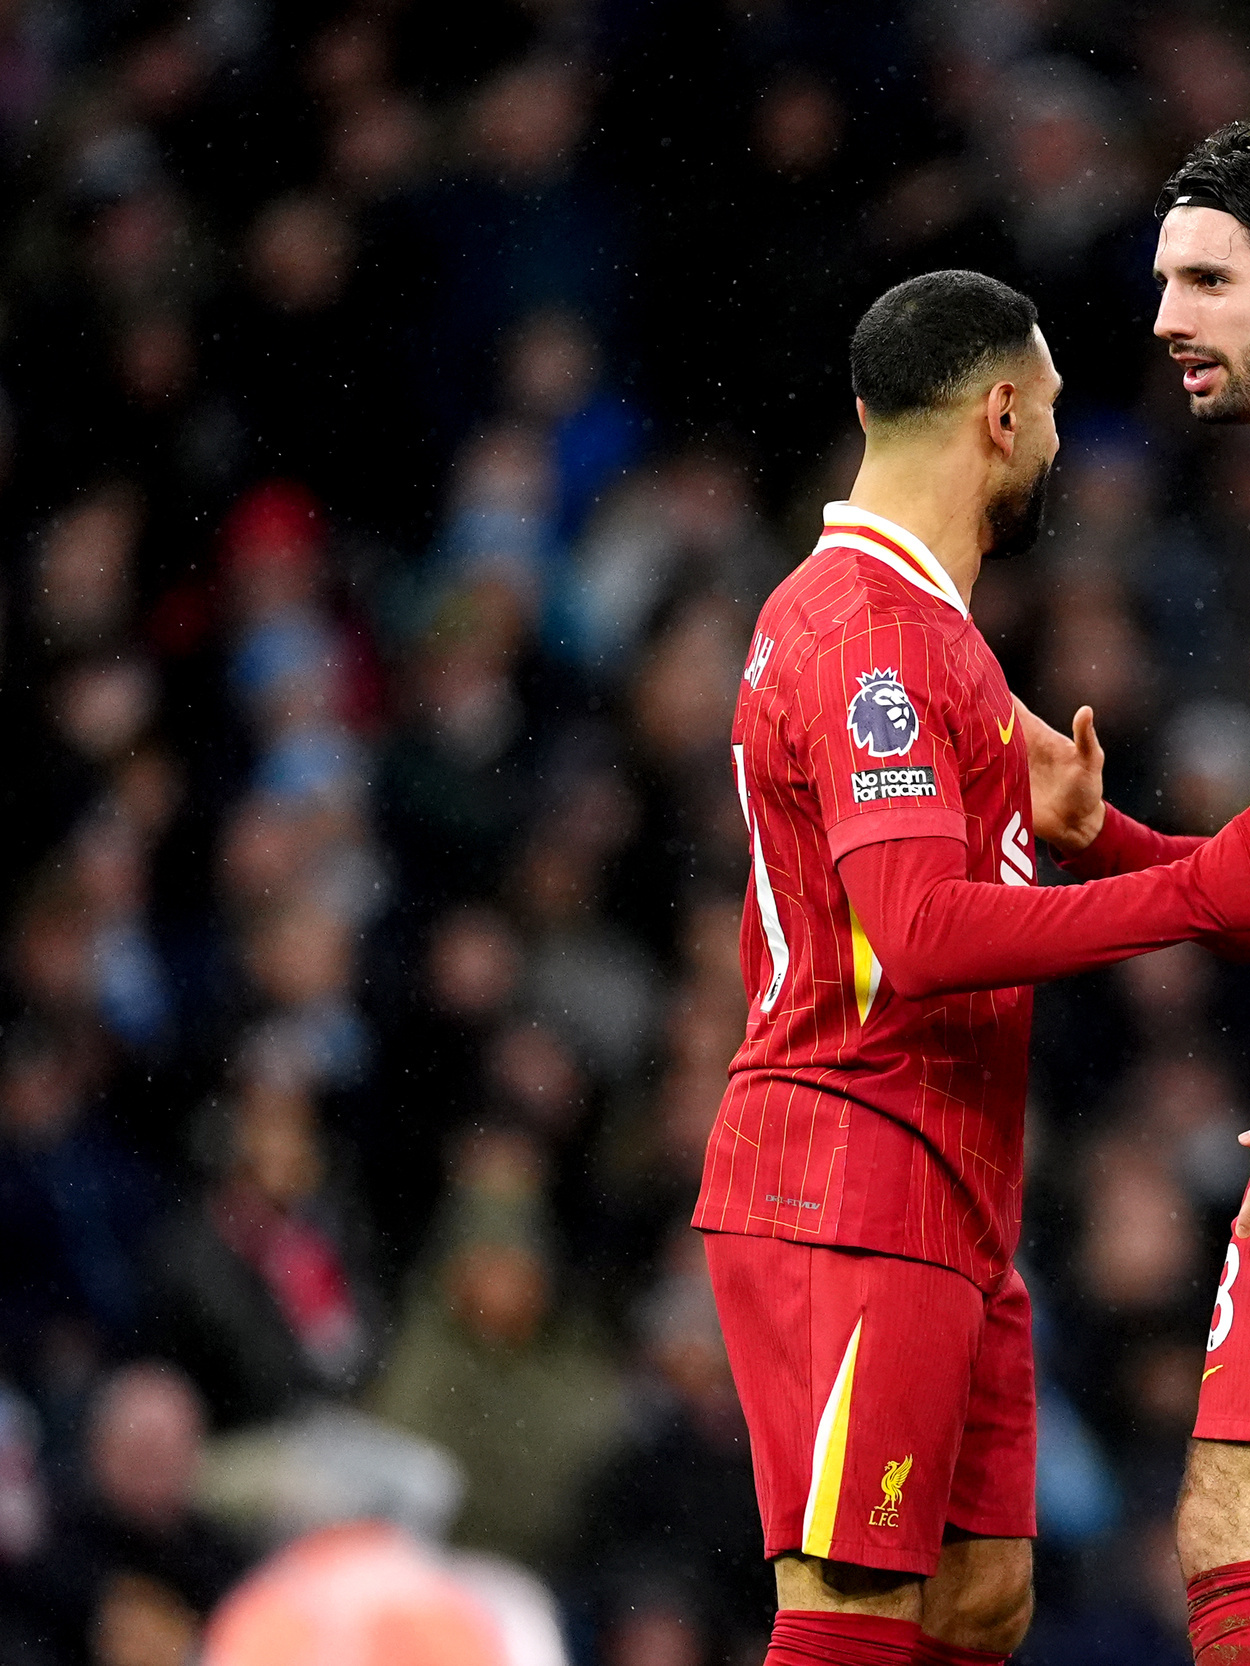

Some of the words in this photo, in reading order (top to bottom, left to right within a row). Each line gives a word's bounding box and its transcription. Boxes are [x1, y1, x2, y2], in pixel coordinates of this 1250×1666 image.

[743, 628, 775, 690] AH
[850, 771, 878, 789] No
[880, 769, 928, 785] room
[853, 786, 879, 804] for
[880, 783, 937, 799] racism
[868, 1510, 900, 1528] L.F.C.
